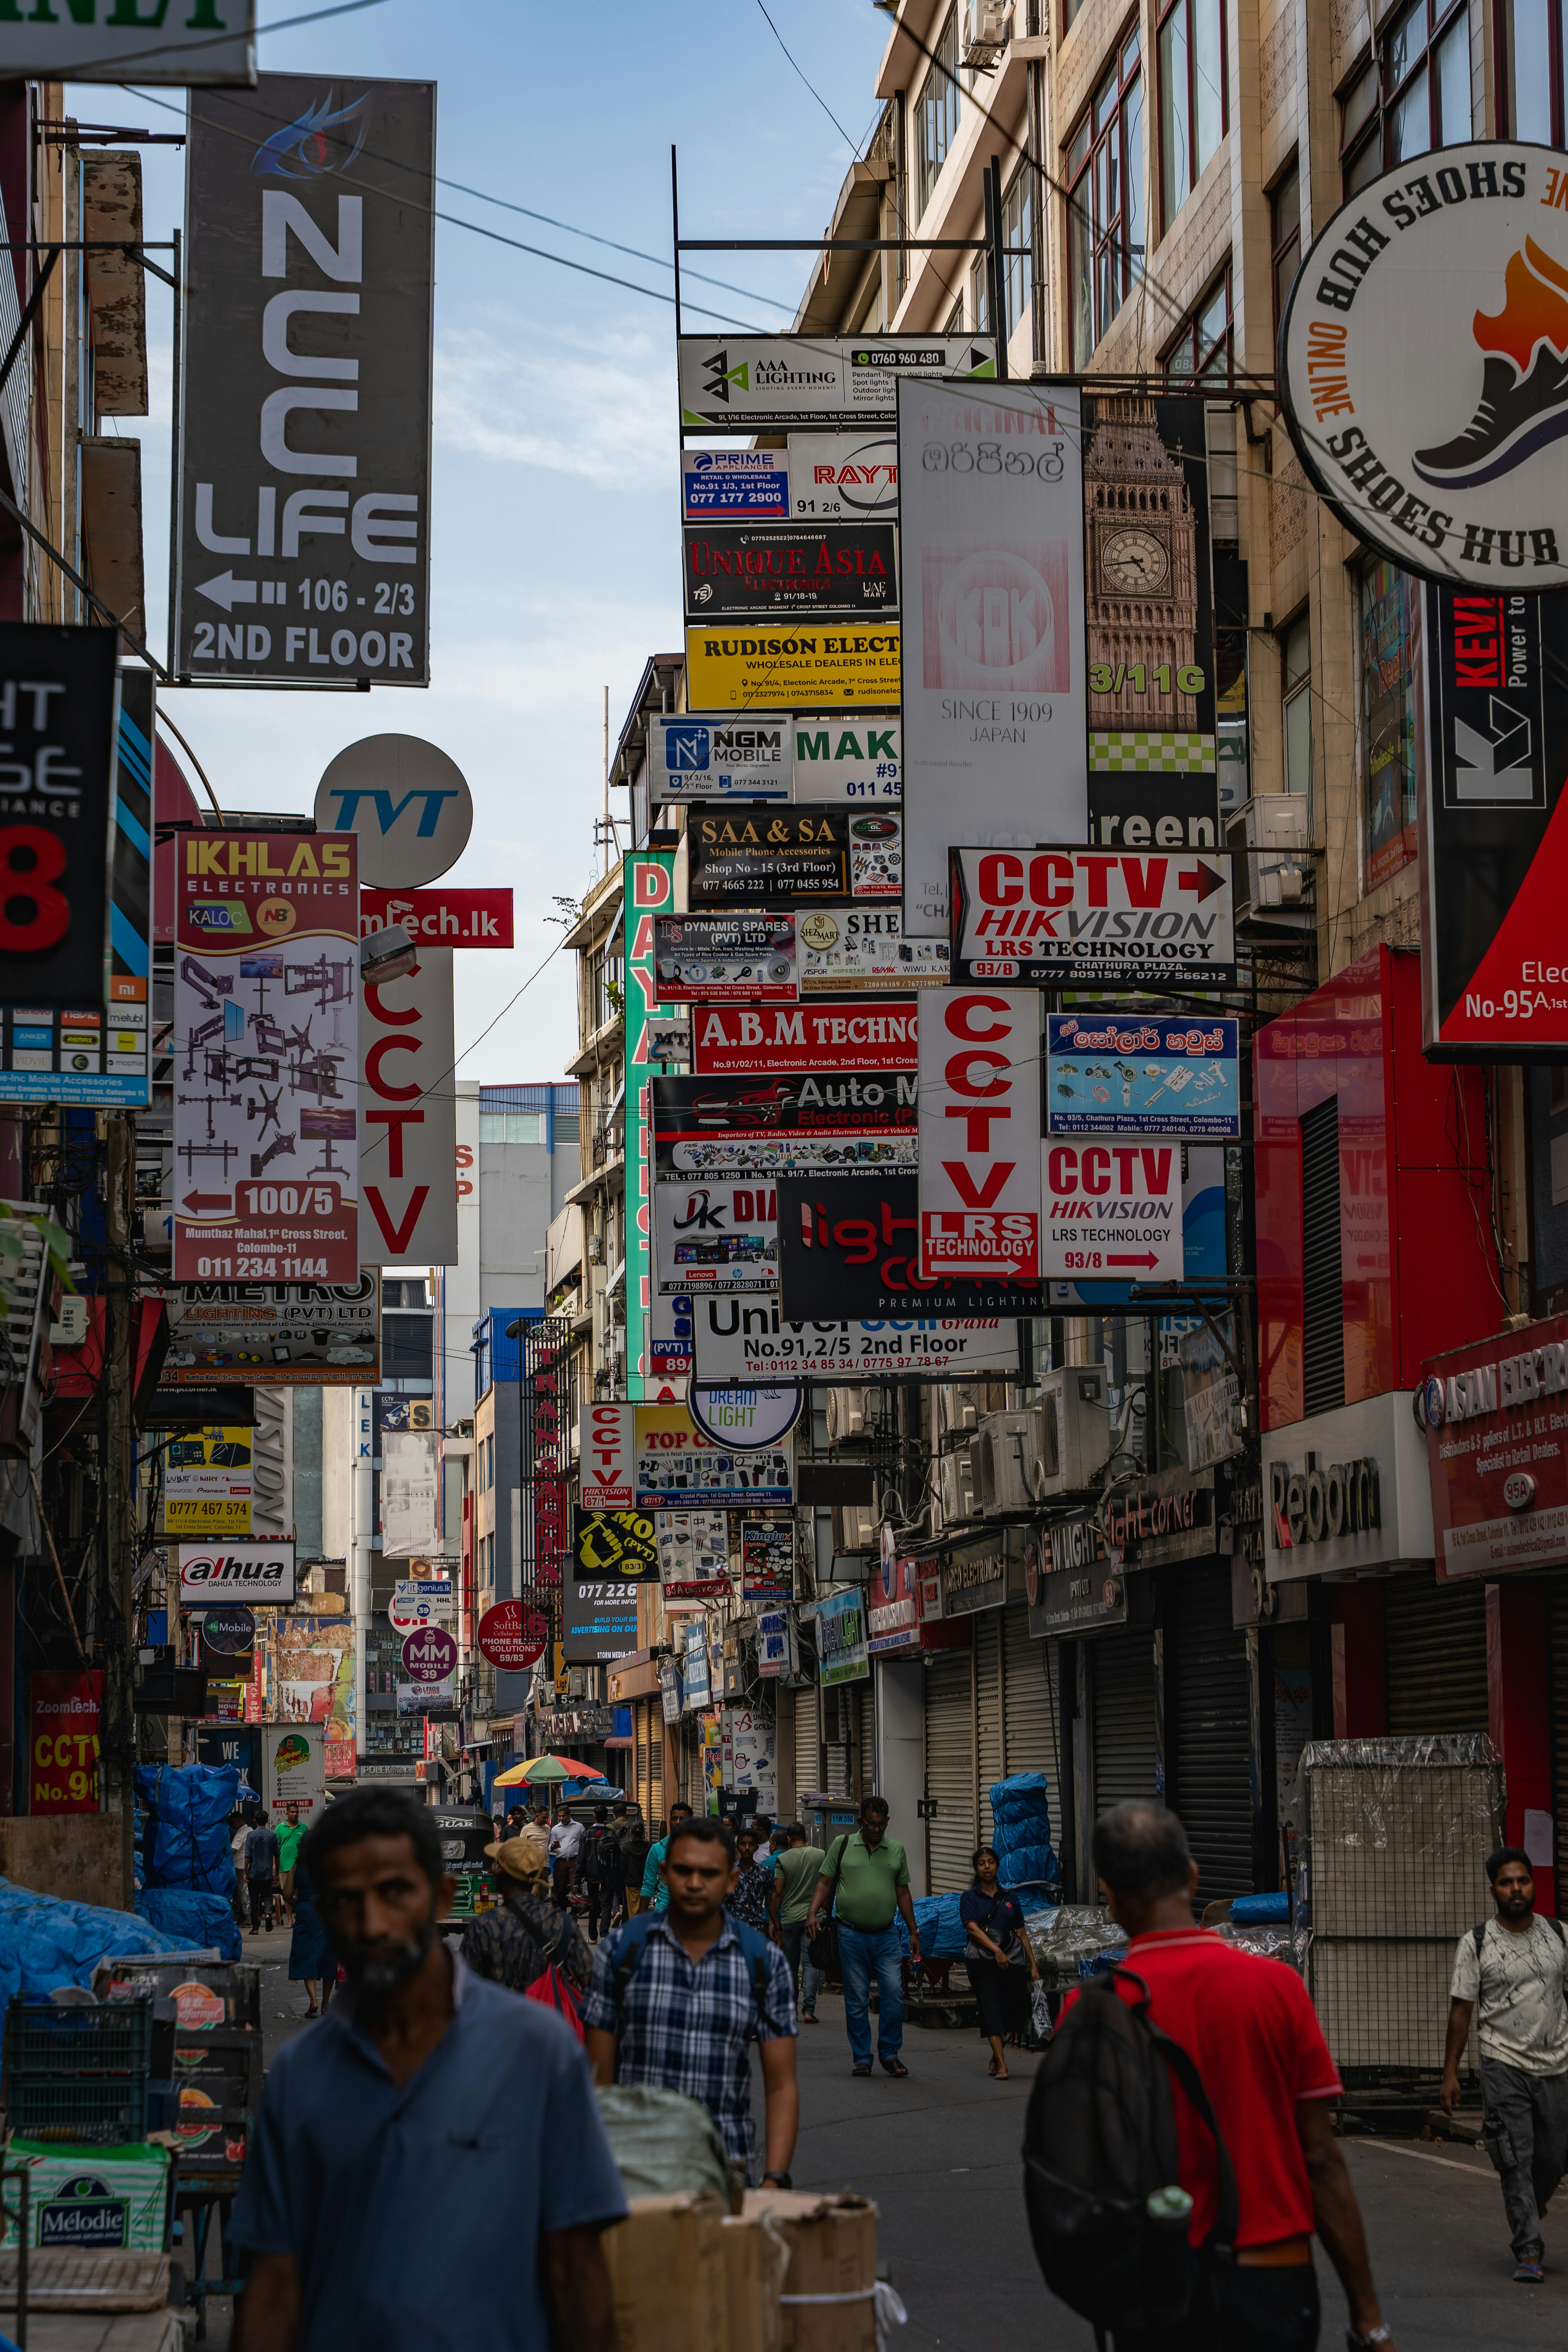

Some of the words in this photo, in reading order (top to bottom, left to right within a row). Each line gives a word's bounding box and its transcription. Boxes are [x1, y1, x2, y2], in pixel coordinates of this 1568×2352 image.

[1382, 161, 1526, 231] SHOES
[1316, 216, 1391, 312] HUB
[755, 359, 788, 371] AAA
[871, 353, 897, 364] 0760
[899, 353, 916, 364] 960
[920, 353, 939, 363] 480
[757, 372, 835, 384] LIGHTING
[1307, 320, 1356, 423] ONLINE
[715, 454, 774, 465] PRIME
[1326, 426, 1454, 549] SHOES
[691, 494, 716, 503] 077
[720, 494, 744, 503] 177
[749, 493, 781, 502] 2900
[797, 500, 815, 513] 91
[822, 503, 840, 513] 2/6
[196, 483, 417, 563] LIFE
[1460, 523, 1559, 567] HUB
[815, 541, 887, 575] ASIA
[298, 579, 347, 613] 106
[375, 583, 415, 616] 2/3
[194, 622, 270, 661] 2ND
[285, 627, 414, 668] FLOOR
[704, 638, 817, 657] RUDISON
[746, 660, 811, 669] WHOLESALE
[815, 659, 862, 667] DEALERS
[1508, 626, 1527, 687] Power
[1090, 665, 1205, 694] 3/11G
[714, 731, 781, 748] NGM
[714, 750, 781, 761] MOBILE
[330, 790, 459, 837] TVT
[702, 821, 760, 843] SAA
[799, 819, 836, 842] SA
[187, 840, 350, 878] IKHLAS
[710, 848, 742, 857] Mobile
[746, 848, 775, 857] Phone
[777, 847, 830, 855] Accessories
[705, 864, 731, 875] Shop
[703, 880, 720, 891] 077
[722, 880, 744, 890] 4665
[748, 880, 764, 889] 222
[778, 880, 795, 889] 077
[797, 879, 820, 889] 0455
[822, 879, 838, 889] 954
[979, 854, 1169, 909] CCTV
[684, 922, 740, 933] DYNAMIC
[742, 922, 788, 932] SPARES
[711, 933, 740, 945] (PVT)
[745, 933, 766, 942] LTD
[985, 940, 1033, 956] LRS
[1039, 941, 1214, 959] TECHNOLOGY
[977, 963, 1012, 976] 93/8
[1075, 961, 1141, 970] CHATHURA
[701, 1011, 806, 1047] A.B.M
[29, 1075, 61, 1083] Mobile
[64, 1076, 122, 1086] Accessories
[798, 1077, 884, 1107] Auto
[941, 995, 1016, 1208] CCTV
[798, 1109, 889, 1125] Electronic
[1048, 1146, 1172, 1195] CCTV
[245, 1187, 333, 1214] 100/5
[1049, 1201, 1173, 1220] HIKVISION
[186, 1228, 232, 1238] Mumthaz
[930, 1215, 1033, 1239] LRS
[1053, 1229, 1077, 1241] LRS
[1082, 1229, 1171, 1242] TECHNOLOGY
[237, 1243, 296, 1253] Colombo-11
[926, 1239, 1034, 1256] TECHNOLOGY
[198, 1257, 231, 1277] 011
[237, 1258, 277, 1277] 234
[281, 1258, 328, 1278] 1144
[1065, 1252, 1102, 1269] 93/8
[684, 1281, 713, 1290] 7198896
[718, 1281, 731, 1289] 077
[879, 1298, 956, 1307] PREMIUM
[185, 1307, 275, 1319] LIGHTING
[338, 1307, 372, 1319] LTD
[861, 1336, 902, 1354] 2nd
[709, 1406, 756, 1427] LIGHT
[592, 1408, 622, 1486] CCTV
[646, 1432, 688, 1449] TOP
[1507, 1481, 1527, 1501] 95A
[170, 1503, 198, 1514] 0777
[201, 1503, 222, 1515] 467
[227, 1503, 247, 1515] 574
[586, 1497, 605, 1507] 87/1
[1270, 1452, 1380, 1549] Reborn
[745, 1531, 792, 1543] Kinglux
[571, 1624, 610, 1634] ADVERTISING
[410, 1644, 449, 1661] MM
[422, 1670, 437, 1679] 39
[44, 2209, 122, 2233] Mélodie
